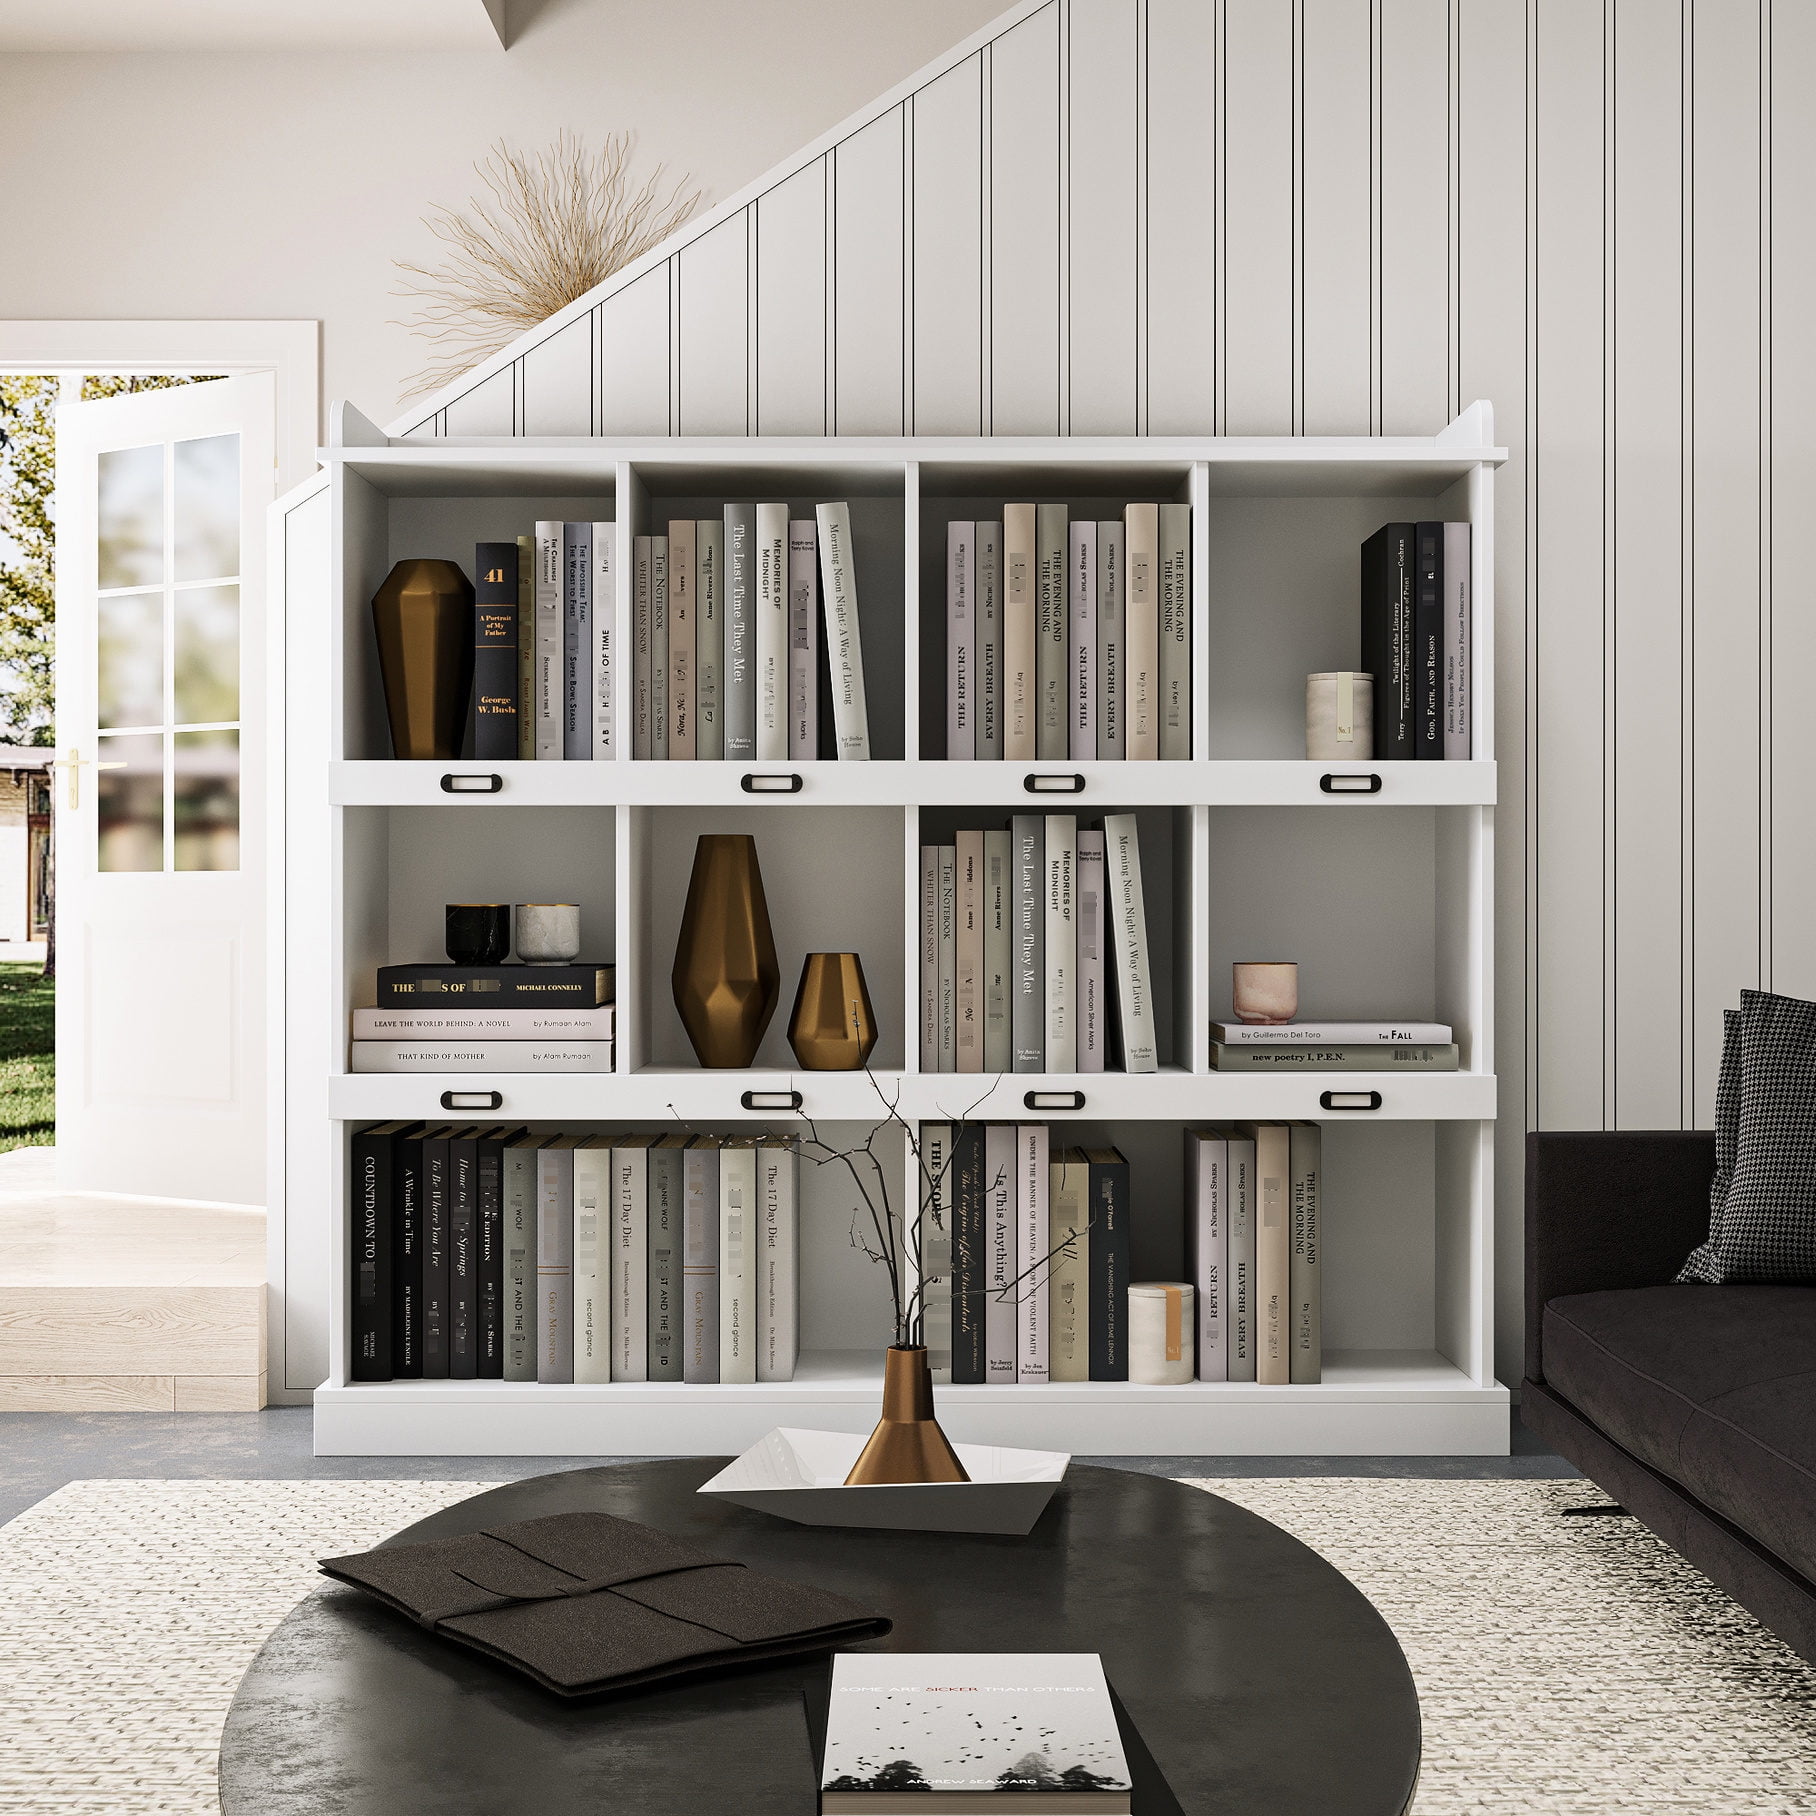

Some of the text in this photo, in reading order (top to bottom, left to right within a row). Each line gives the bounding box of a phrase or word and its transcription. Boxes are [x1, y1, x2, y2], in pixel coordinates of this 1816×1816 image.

[484, 568, 504, 583] 41
[762, 549, 770, 600] MIDNIGHT
[773, 539, 782, 593] MEMORIES
[1042, 560, 1051, 632] THE MORNING
[1053, 550, 1062, 642] THE EVENING AND
[1165, 560, 1173, 632] THE MORNING
[1175, 550, 1184, 642] THE EVENING AND
[495, 623, 504, 631] My
[639, 560, 648, 656] WHITER THAN SNOW
[655, 578, 665, 631] NOTEBOOK
[732, 525, 744, 684] The Last Time They Met
[830, 524, 855, 705] Morning Noon Night: A Way of Living
[478, 705, 516, 714] W. Bush
[481, 695, 511, 705] George
[957, 646, 965, 730] THE RETURN
[985, 643, 993, 740] EVERY BREATH
[1079, 646, 1087, 730] THE RETURN
[1107, 643, 1115, 740] EVERY BREATH
[1051, 860, 1060, 912] MIDNIGHT
[1062, 850, 1071, 905] MEMORIES
[926, 869, 935, 965] WHITER THAN SNOW
[942, 888, 952, 940] NOTEBOOK
[1023, 836, 1035, 995] The Last Time They Met
[1119, 836, 1144, 1017] Morning Noon Night: A Way of Living
[392, 984, 415, 993] THE
[450, 984, 466, 993] OF
[516, 983, 547, 991] MICHAEL
[1087, 978, 1096, 1051] American Silver Marks
[374, 1020, 397, 1028] LEAVE
[399, 1020, 414, 1028] THE
[416, 1020, 443, 1028] WORLD
[478, 1020, 485, 1028] A
[487, 1020, 511, 1028] NOVEL
[398, 1052, 486, 1060] THAT KIND OF MOTHER
[1241, 1030, 1251, 1039] by
[1251, 1053, 1272, 1061] new
[1273, 1053, 1305, 1062] poetry
[1316, 1052, 1345, 1061] P.E.N.
[1390, 1029, 1412, 1039] FALL
[365, 1156, 375, 1238] COUNTDOWN
[405, 1168, 413, 1255] A Wrinkle in Time
[431, 1159, 441, 1267] To Be Where You Are
[457, 1158, 469, 1277] Home to Springs
[622, 1165, 632, 1248] The 17 Day Diet
[768, 1165, 778, 1248] The 17 Day Diet
[996, 1190, 1007, 1217] This
[1030, 1211, 1037, 1221] OF
[1295, 1182, 1304, 1255] THE MORNING
[1306, 1172, 1316, 1264] THE EVENING AND
[365, 1241, 375, 1258] TO
[996, 1220, 1007, 1289] Anything?
[1210, 1265, 1218, 1318] RETURN
[1238, 1262, 1246, 1360] EVERY BREATH
[585, 1298, 595, 1357] second glance
[731, 1298, 741, 1357] second glance
